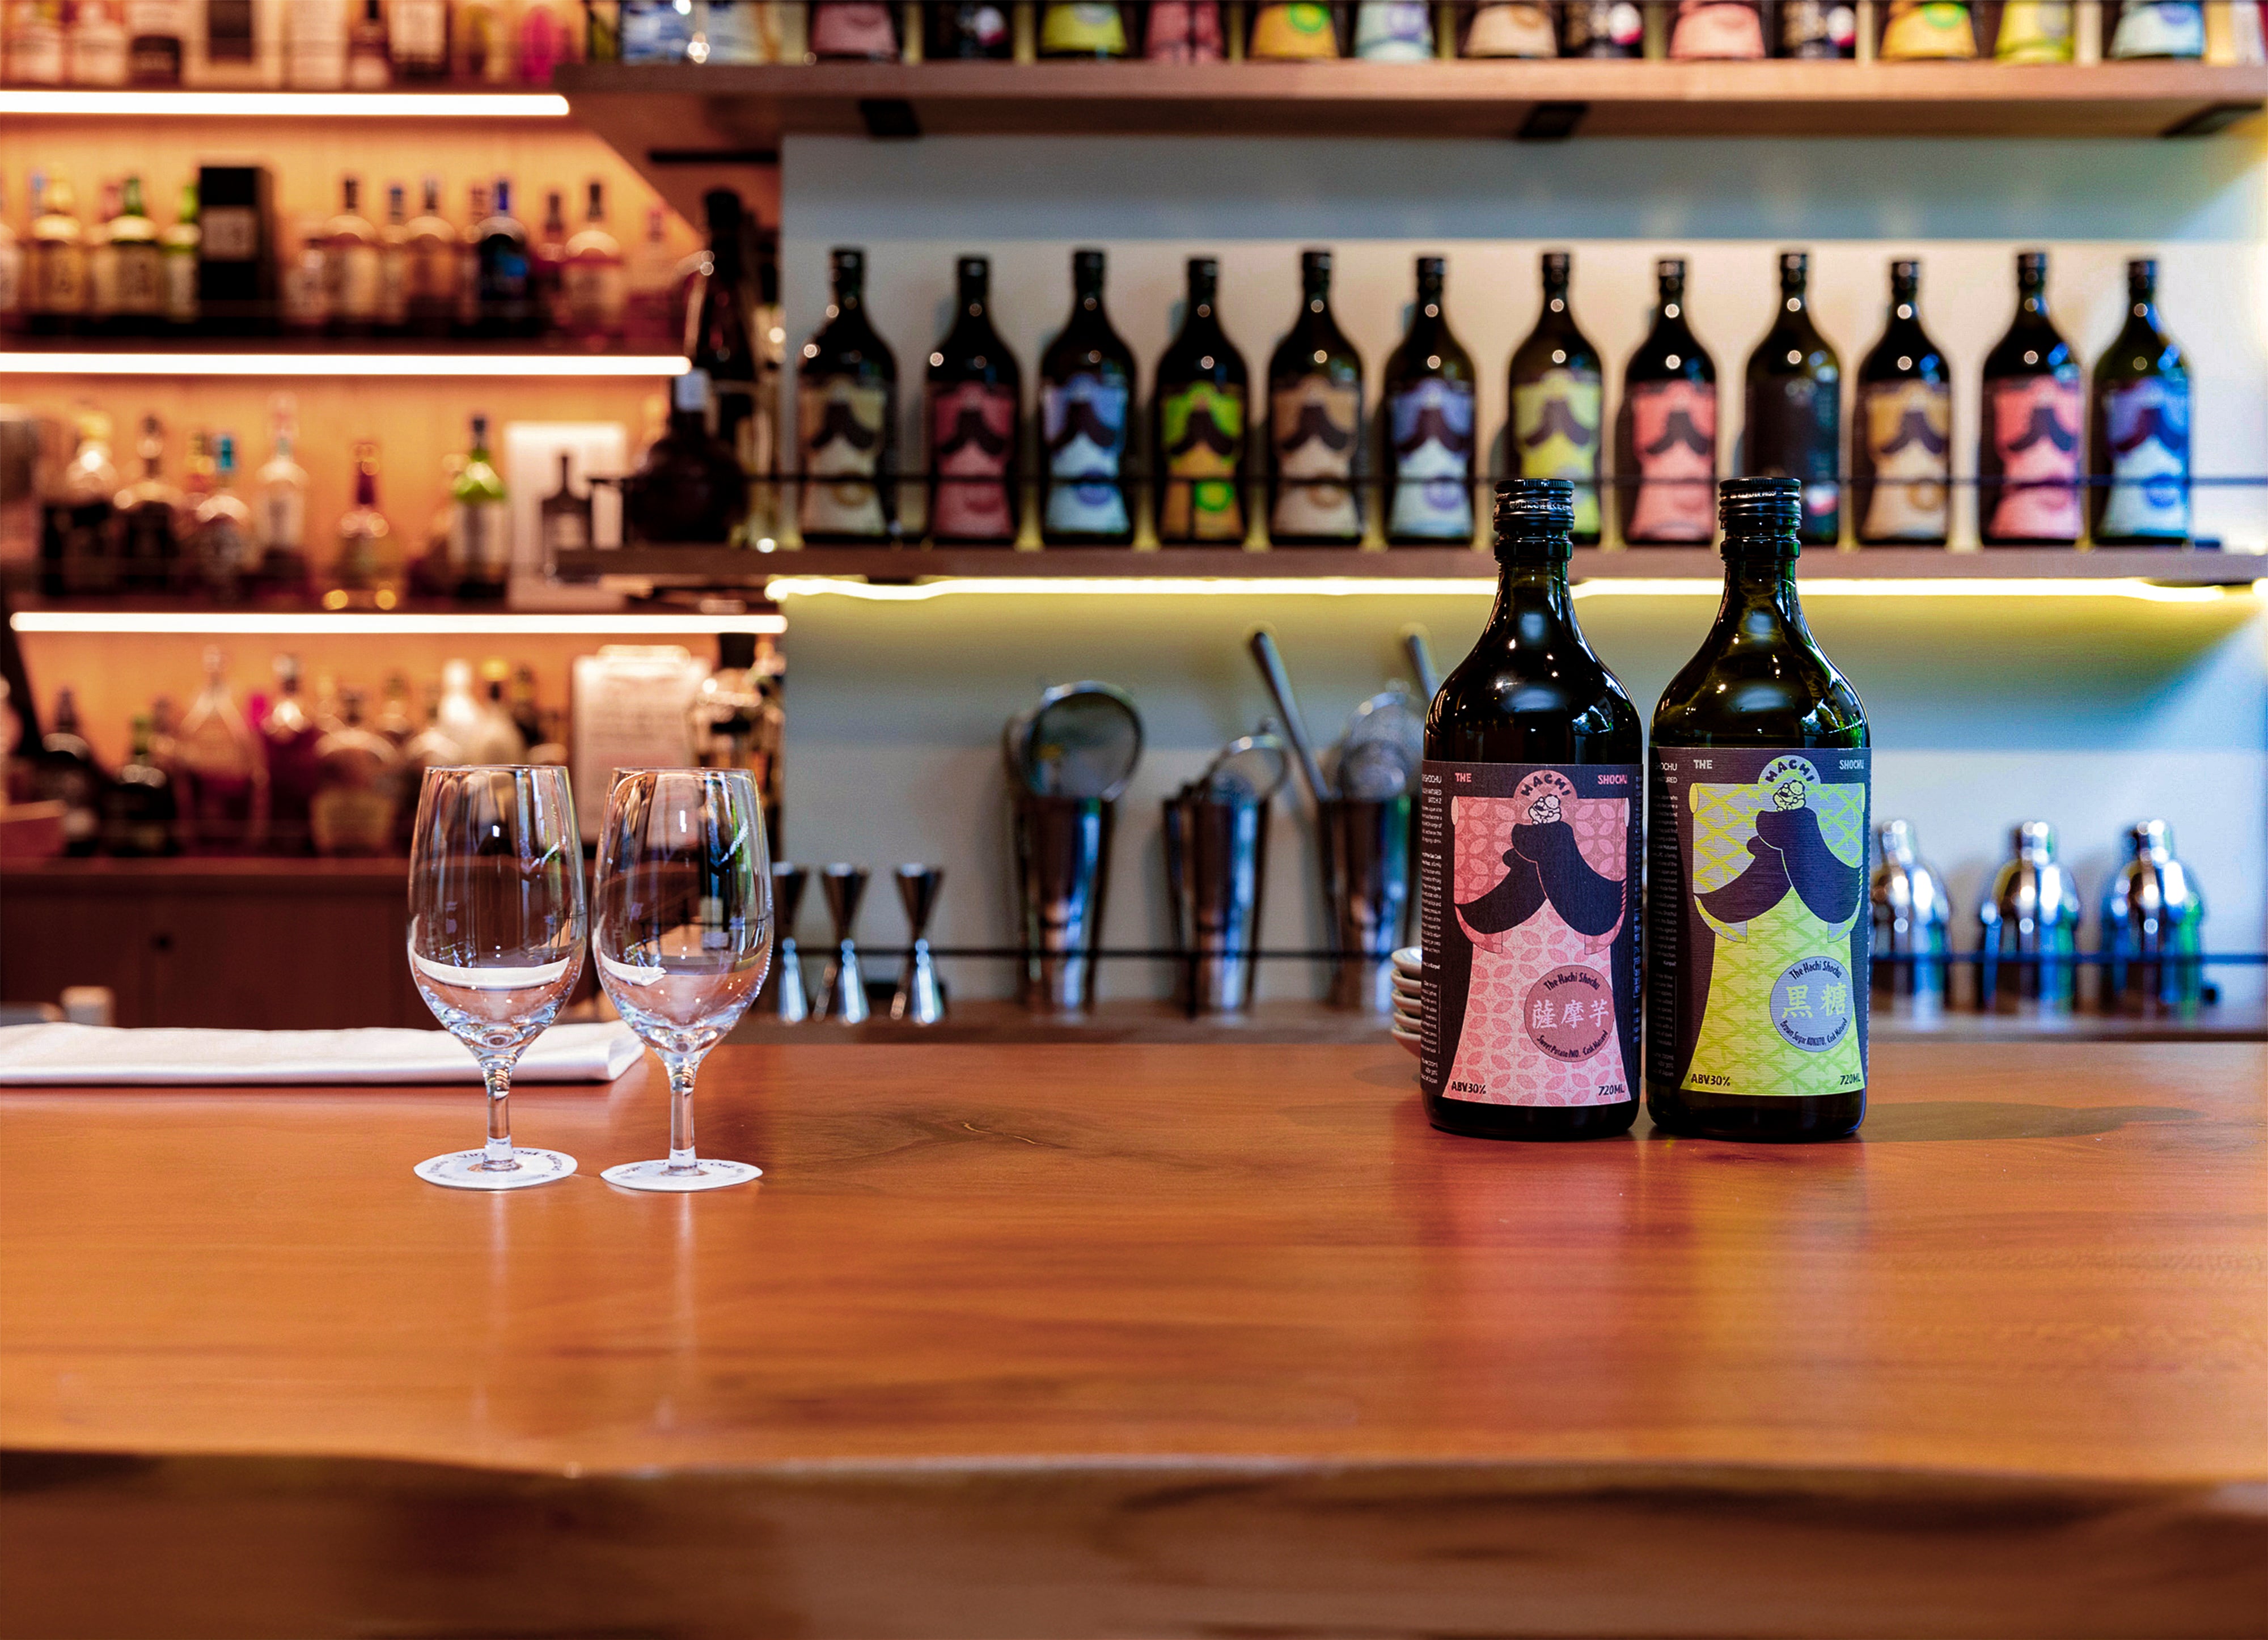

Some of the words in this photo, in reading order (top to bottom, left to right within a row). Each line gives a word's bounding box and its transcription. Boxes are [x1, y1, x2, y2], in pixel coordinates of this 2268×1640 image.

[1693, 760, 1713, 769] THE
[1765, 759, 1815, 783] HACHI
[1839, 759, 1864, 770] SHOCHU
[1454, 773, 1472, 782] THE
[1521, 774, 1571, 796] HACHI
[1597, 774, 1628, 785] SHOCHU
[1543, 980, 1558, 990] The
[1558, 972, 1577, 984] Hachi
[1579, 972, 1600, 990] Shochu
[1789, 969, 1804, 980] The
[1803, 961, 1821, 973] Hachi
[1822, 961, 1842, 978] Shochu
[1782, 982, 1847, 1019] 黒糖
[1532, 999, 1609, 1029] 薩摩芋
[1780, 1020, 1795, 1037] Brown
[1792, 1031, 1806, 1044] Sugar
[1827, 1032, 1837, 1043] Cask
[1537, 1035, 1552, 1050] Sweet
[1550, 1045, 1568, 1057] Potato
[1583, 1045, 1594, 1055] Cask
[1598, 1084, 1624, 1096] 720ML
[1840, 1073, 1861, 1085] 720ML
